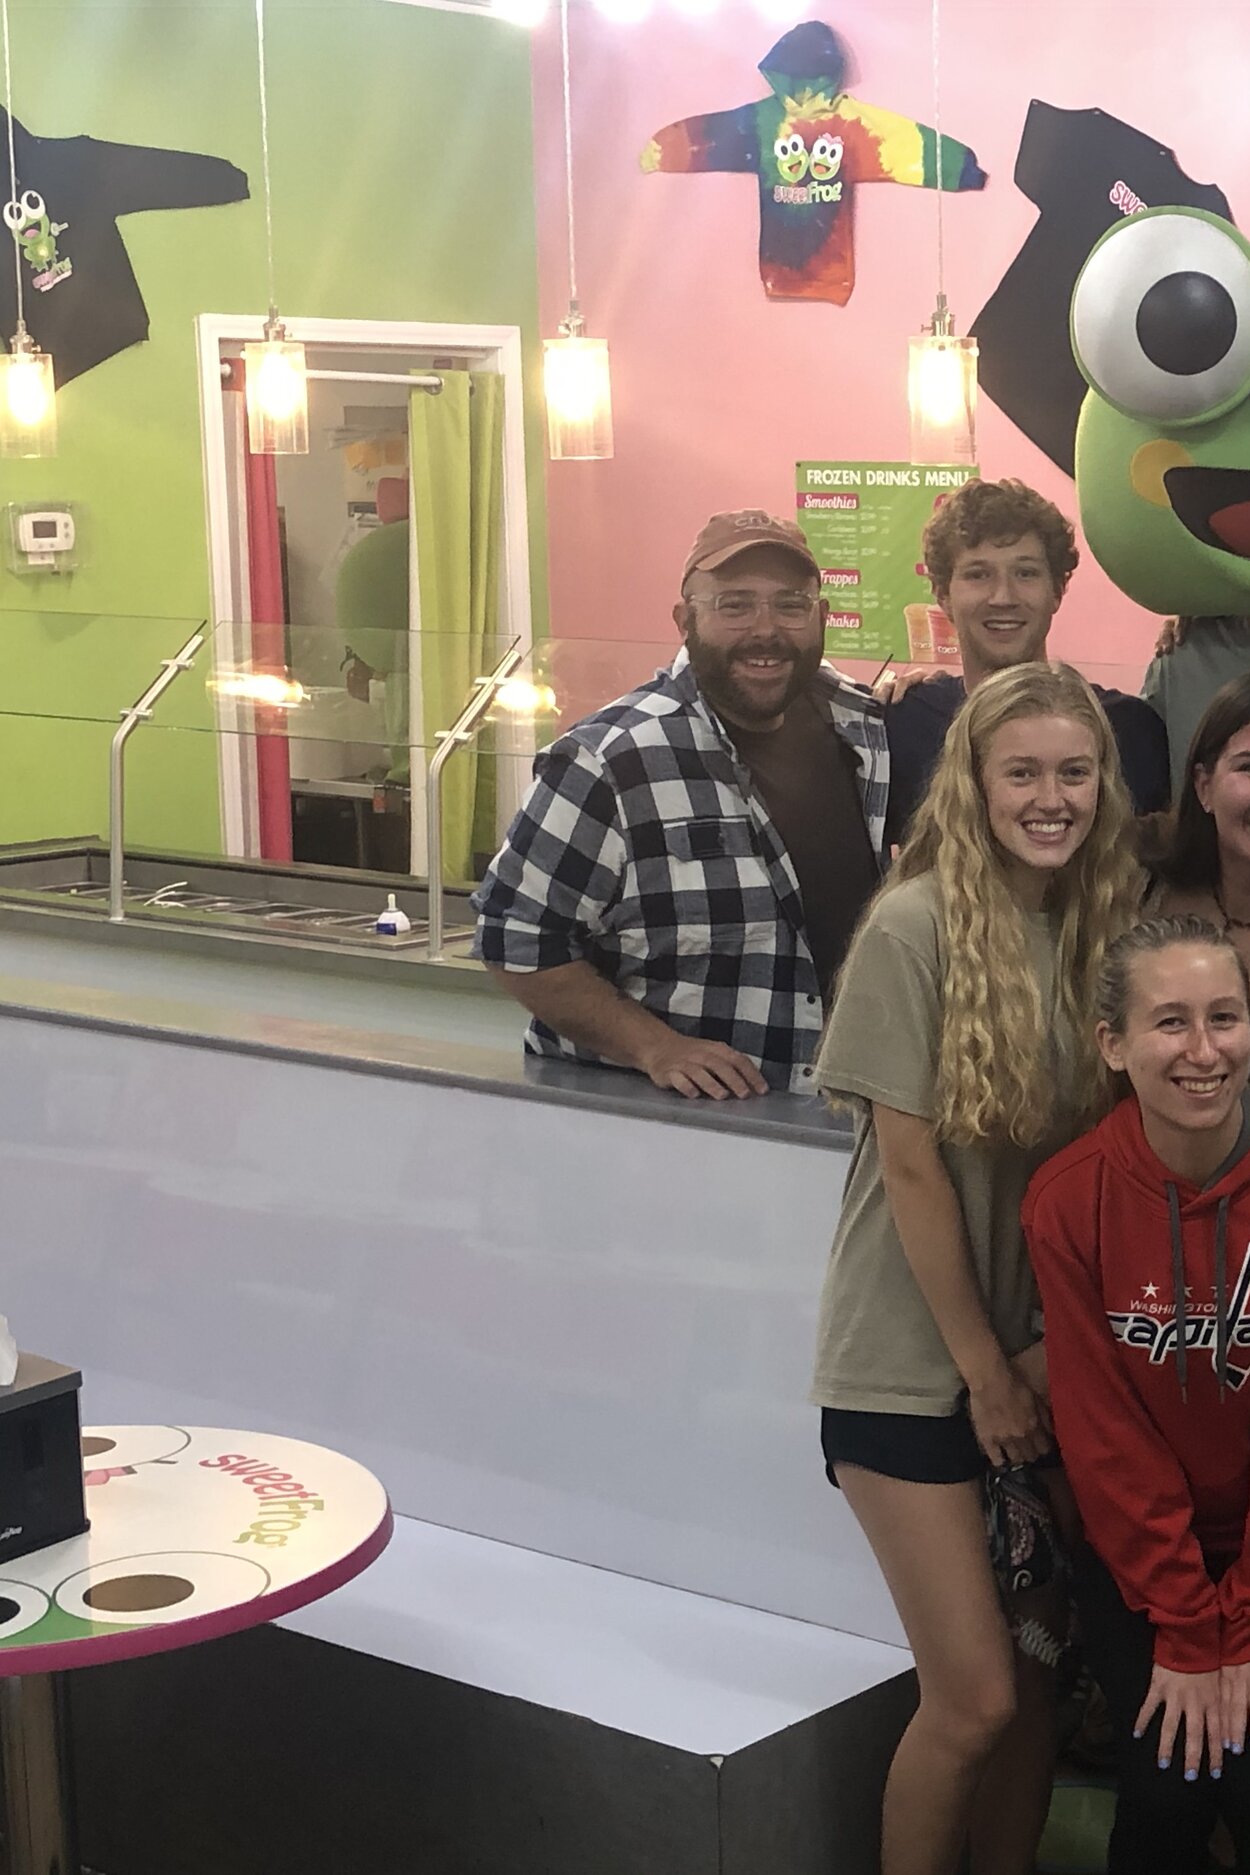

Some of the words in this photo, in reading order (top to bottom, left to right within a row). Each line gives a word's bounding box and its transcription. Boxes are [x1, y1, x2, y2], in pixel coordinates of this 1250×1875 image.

[806, 469, 861, 485] FROZEN
[866, 470, 920, 486] DRINKS
[925, 471, 969, 486] MENU
[804, 494, 857, 510] Smoothies
[820, 570, 858, 588] Frappes
[1130, 1299, 1219, 1315] WASHIGTO
[199, 1453, 325, 1548] sweetFrog
